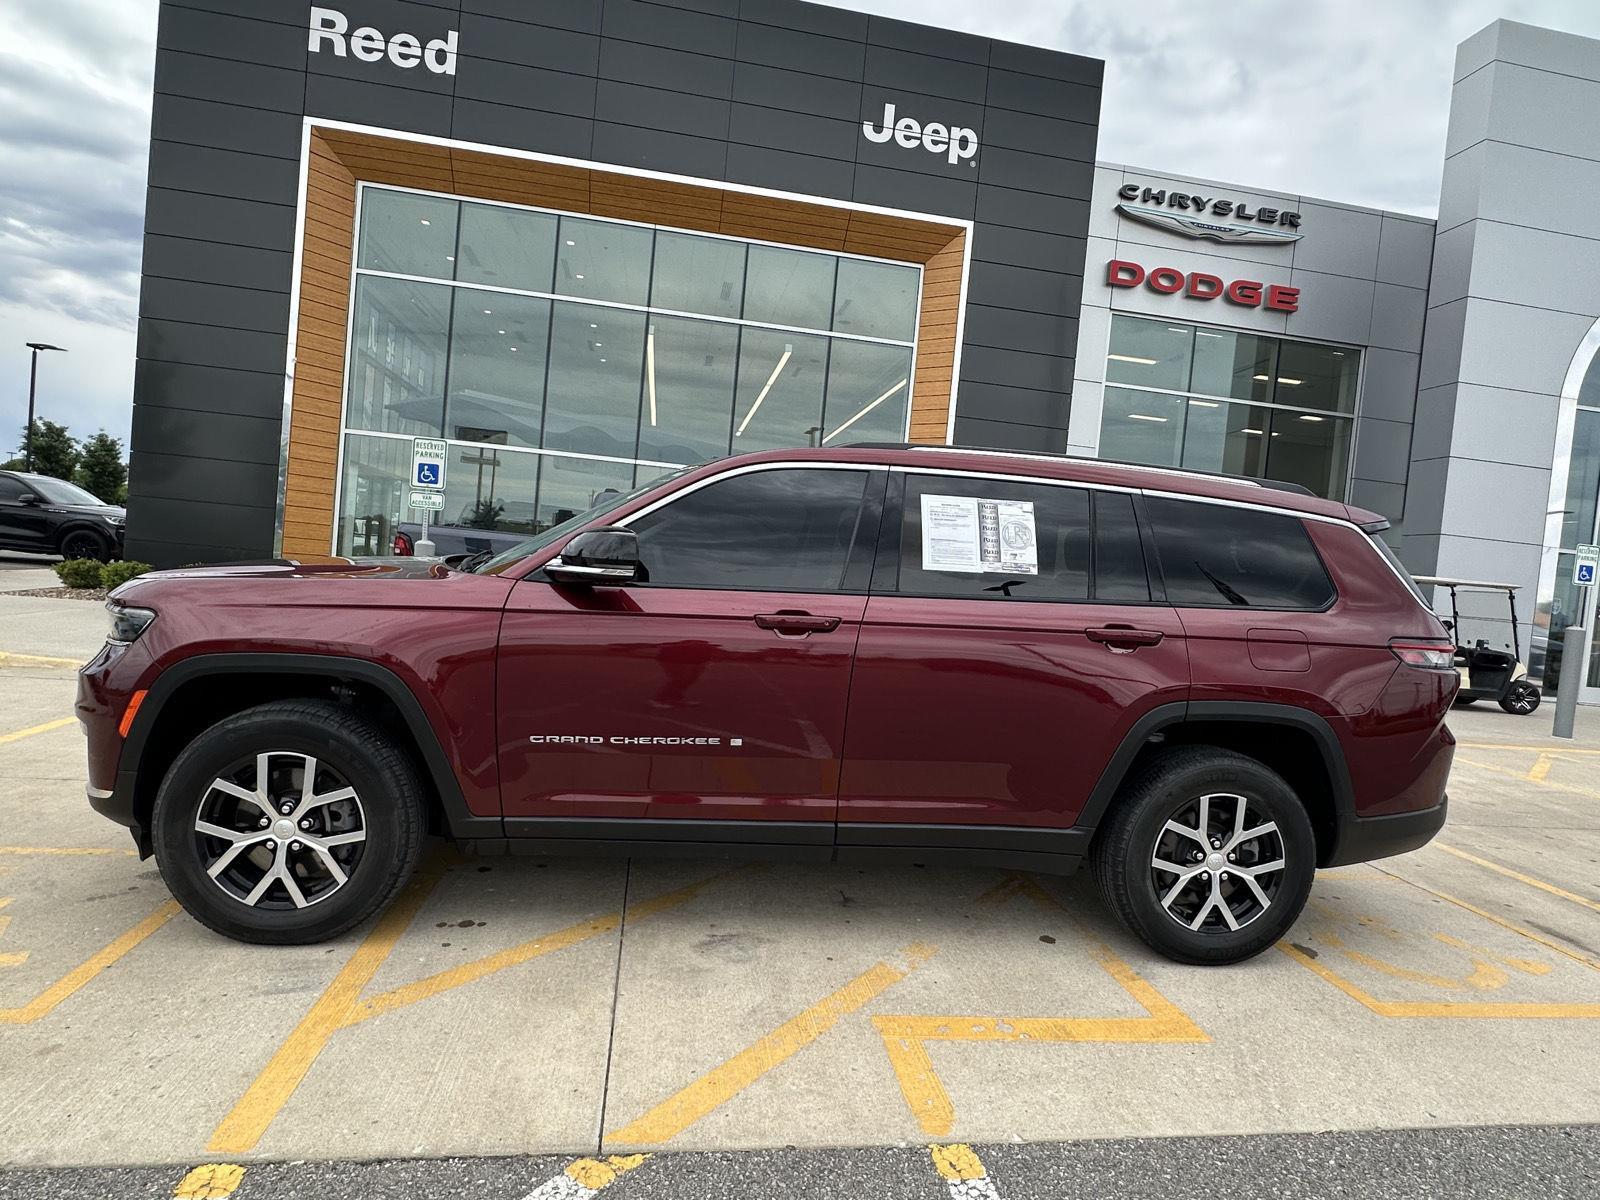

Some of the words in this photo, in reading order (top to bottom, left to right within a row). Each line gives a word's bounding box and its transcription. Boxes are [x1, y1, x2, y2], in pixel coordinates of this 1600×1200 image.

[308, 6, 459, 75] Reed
[862, 102, 979, 165] Jeep
[1117, 183, 1302, 227] CHRYSLER
[1106, 258, 1301, 313] DODGE
[415, 441, 445, 451] RESERVED
[415, 450, 444, 460] PARKING
[529, 735, 604, 744] GRAND
[609, 736, 721, 745] CHEROKEE
